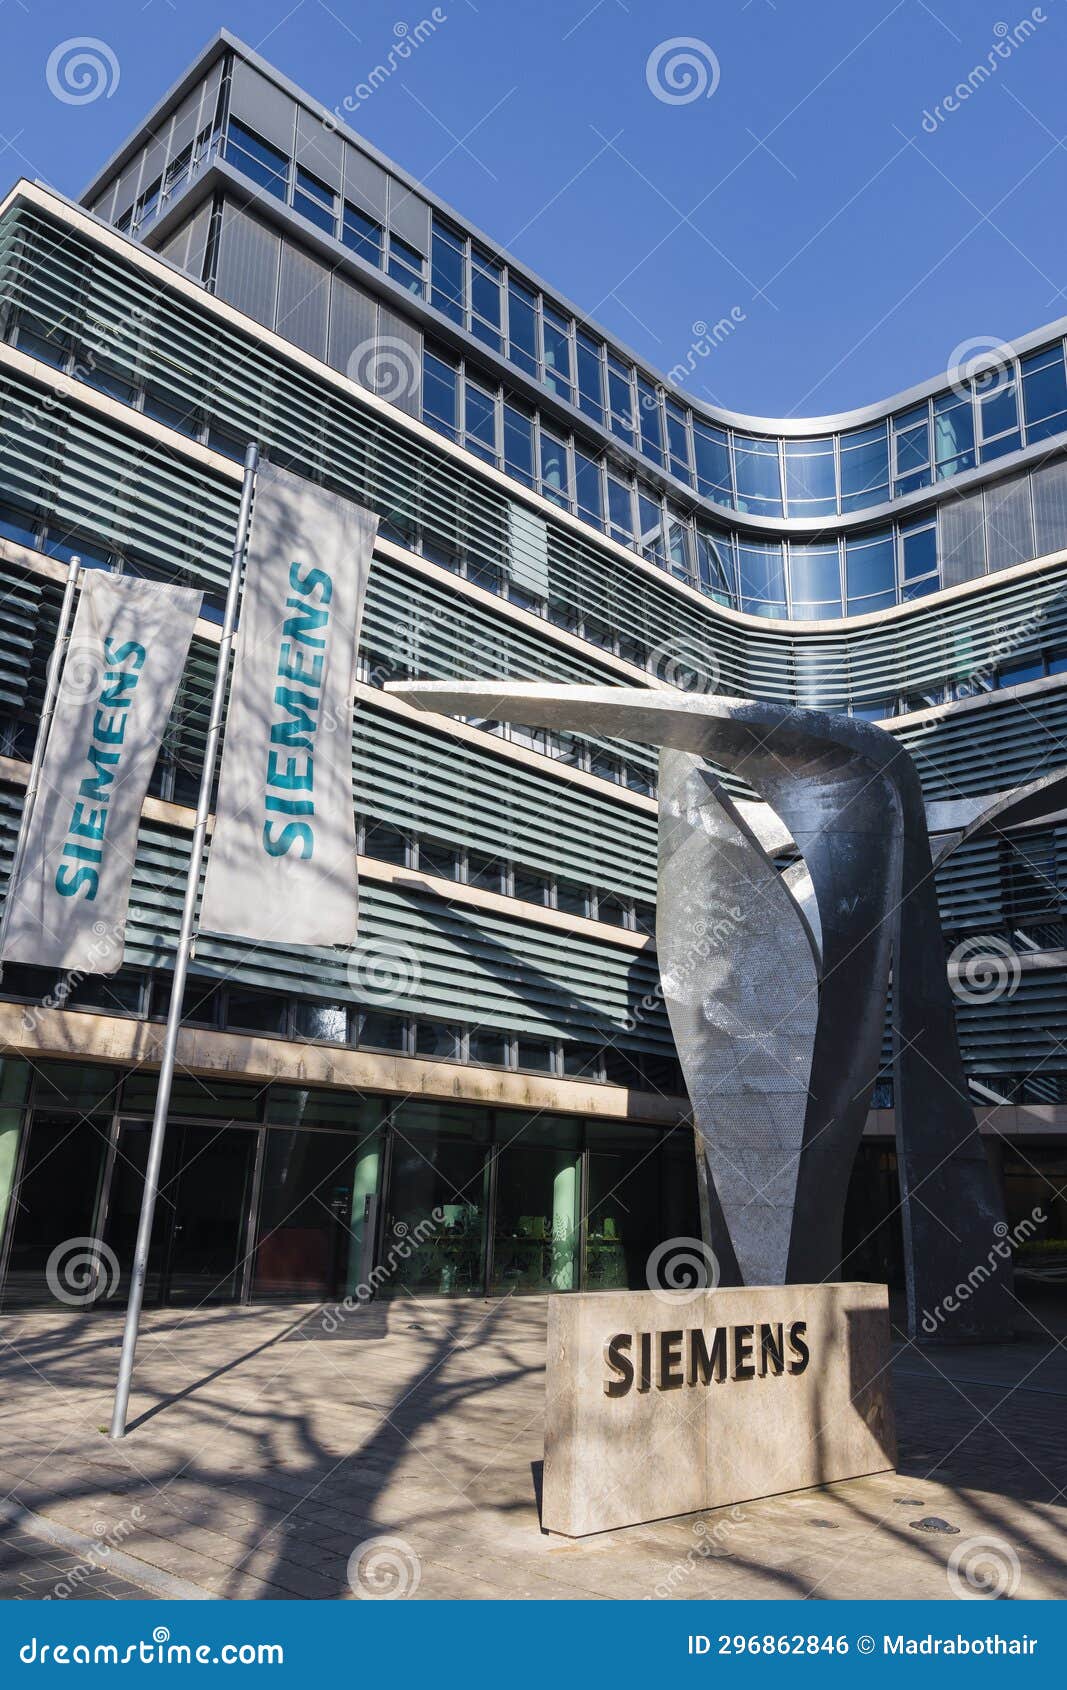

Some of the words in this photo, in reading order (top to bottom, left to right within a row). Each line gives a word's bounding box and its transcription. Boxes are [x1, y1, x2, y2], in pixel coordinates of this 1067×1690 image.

[55, 637, 147, 901] SIEMENS
[263, 562, 333, 860] SIEMENS
[603, 1321, 809, 1398] SIEMENS
